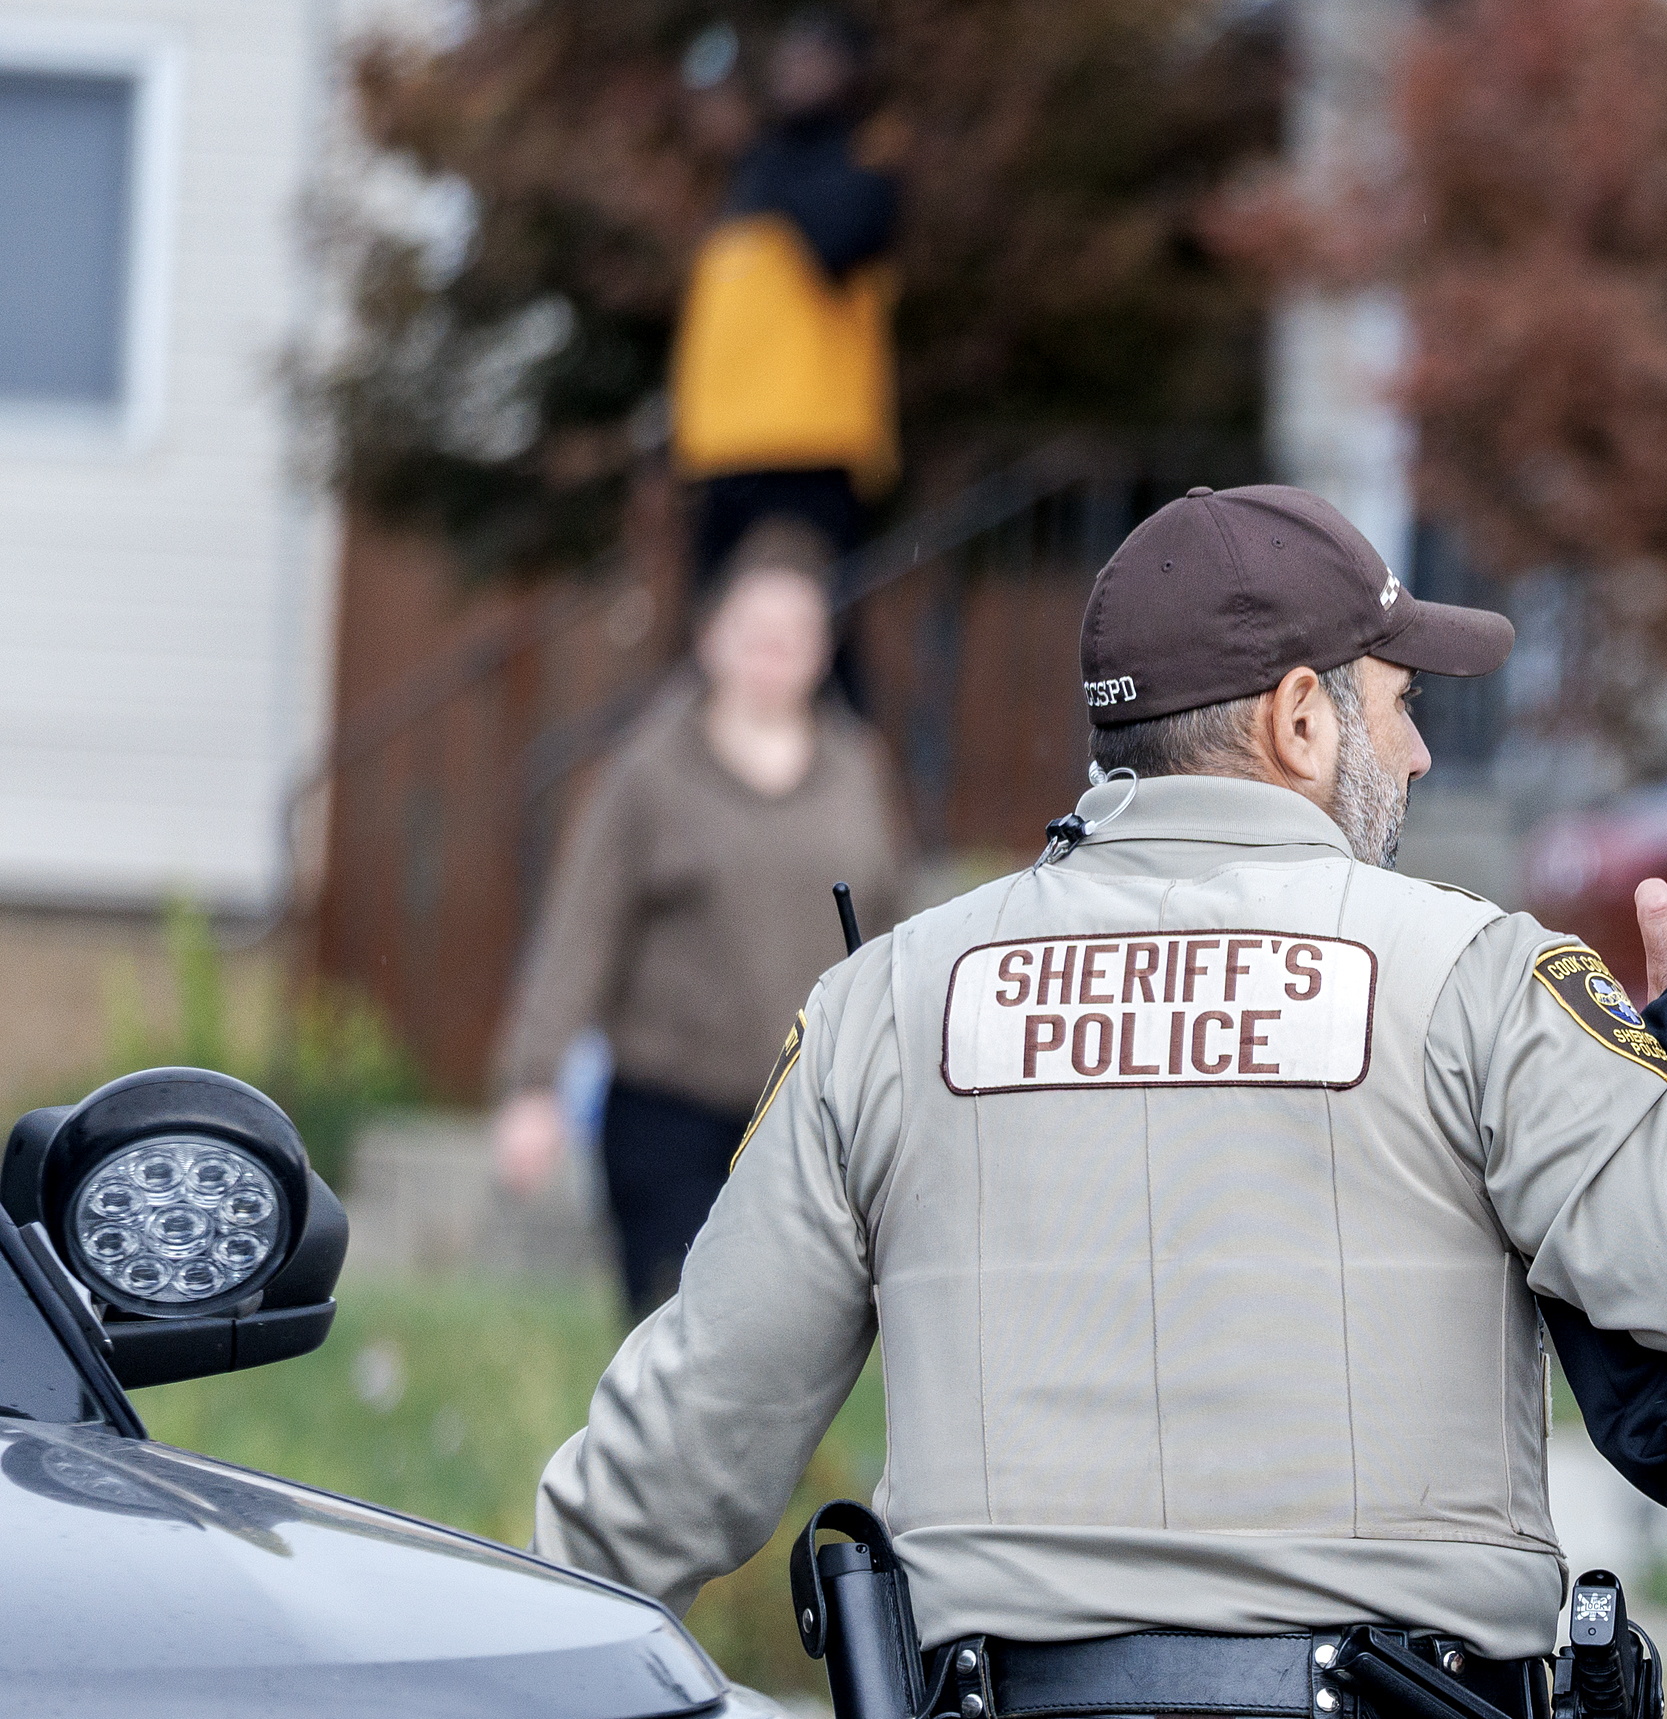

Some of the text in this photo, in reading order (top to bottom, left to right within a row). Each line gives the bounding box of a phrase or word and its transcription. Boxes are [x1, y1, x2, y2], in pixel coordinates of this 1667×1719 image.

[1083, 675, 1137, 707] CCSPD
[995, 939, 1323, 1007] SHERIFF'S
[1547, 955, 1586, 980] COOK
[1023, 1010, 1282, 1079] POLICE
